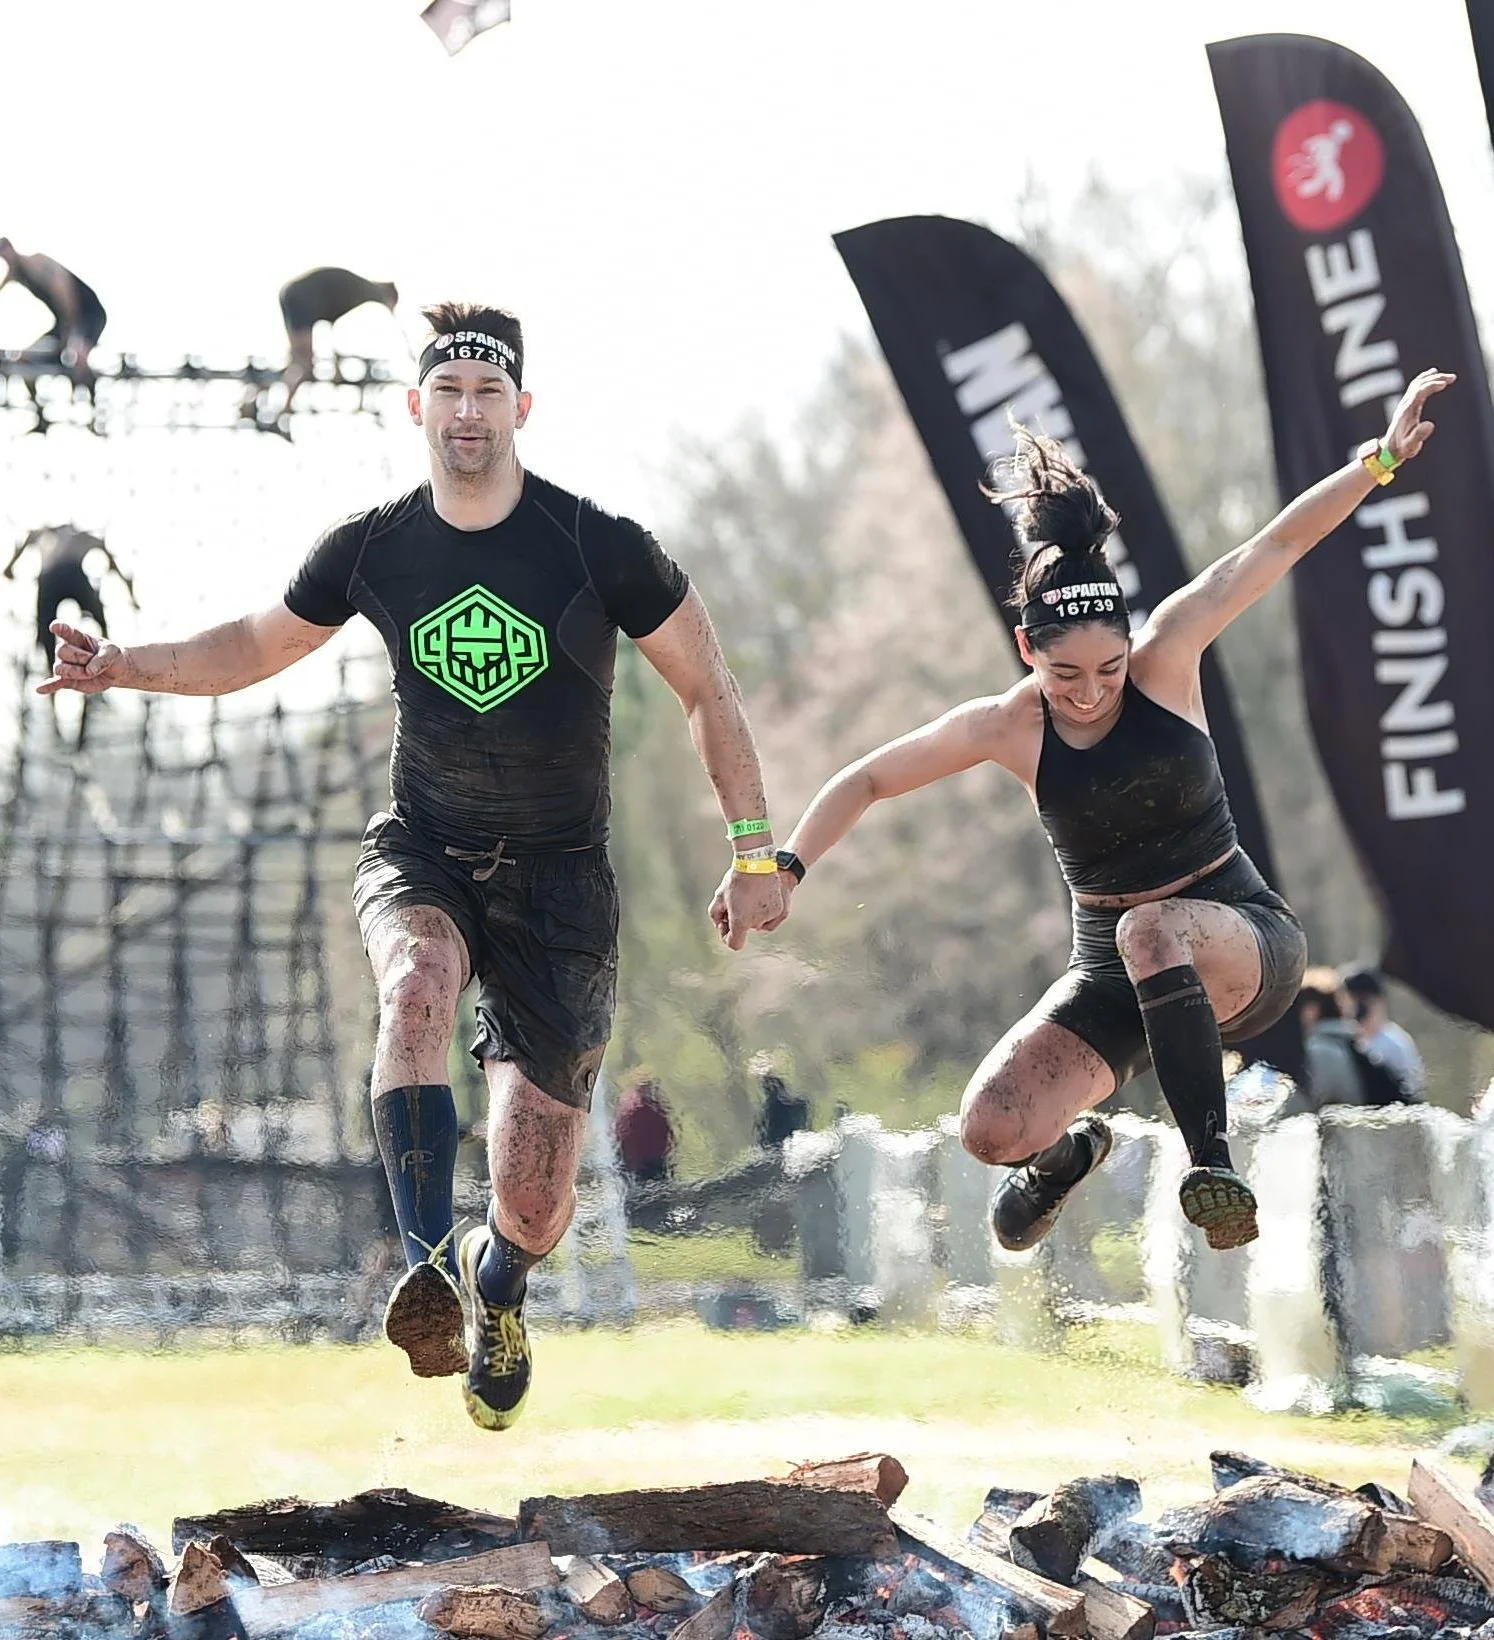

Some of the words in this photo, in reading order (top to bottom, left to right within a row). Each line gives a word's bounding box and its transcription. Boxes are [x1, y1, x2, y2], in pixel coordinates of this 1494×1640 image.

[446, 346, 507, 370] 16738
[455, 331, 515, 364] SPARTAN
[1061, 583, 1119, 600] SPARTAN
[1055, 599, 1114, 618] 16739
[1355, 491, 1467, 822] FINISH
